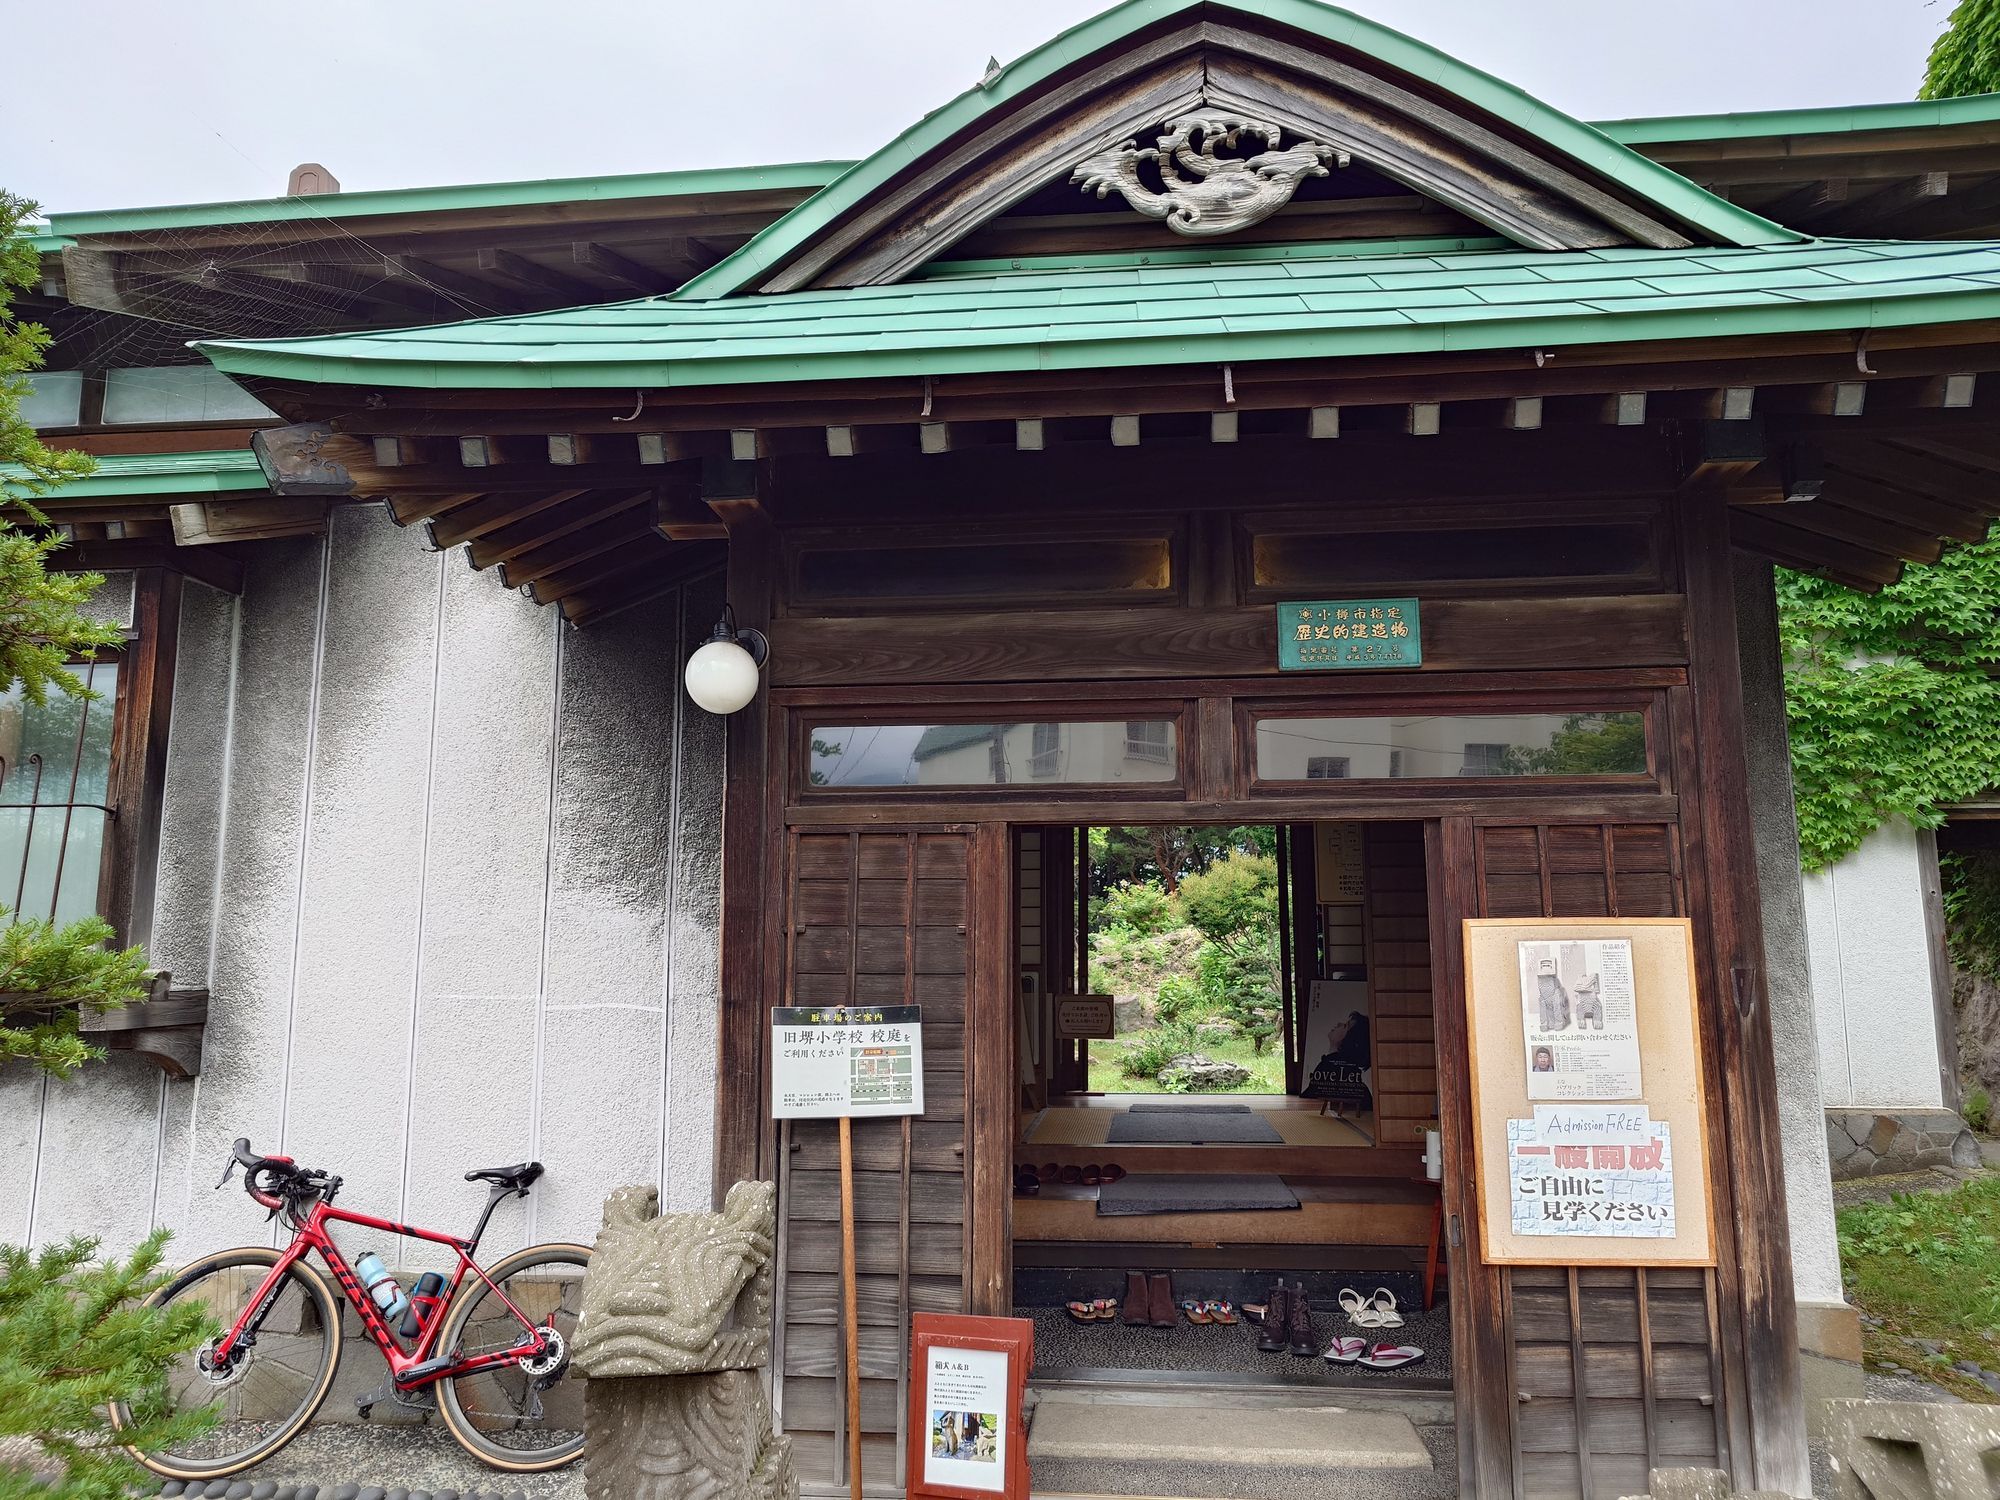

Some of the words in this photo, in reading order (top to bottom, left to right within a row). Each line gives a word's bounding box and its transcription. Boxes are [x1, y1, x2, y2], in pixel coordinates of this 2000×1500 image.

[1318, 607, 1402, 621] 小樽市指定
[811, 1013, 884, 1023] 駐車場のご案内
[784, 1030, 864, 1045] 旧堺小学校
[870, 1028, 911, 1044] 校庭を
[783, 1048, 845, 1059] ご利用ください
[1547, 1114, 1604, 1134] Admission
[1606, 1112, 1642, 1134] FREE
[1519, 1176, 1604, 1196] ご自由に
[1542, 1200, 1669, 1222] 見学ください
